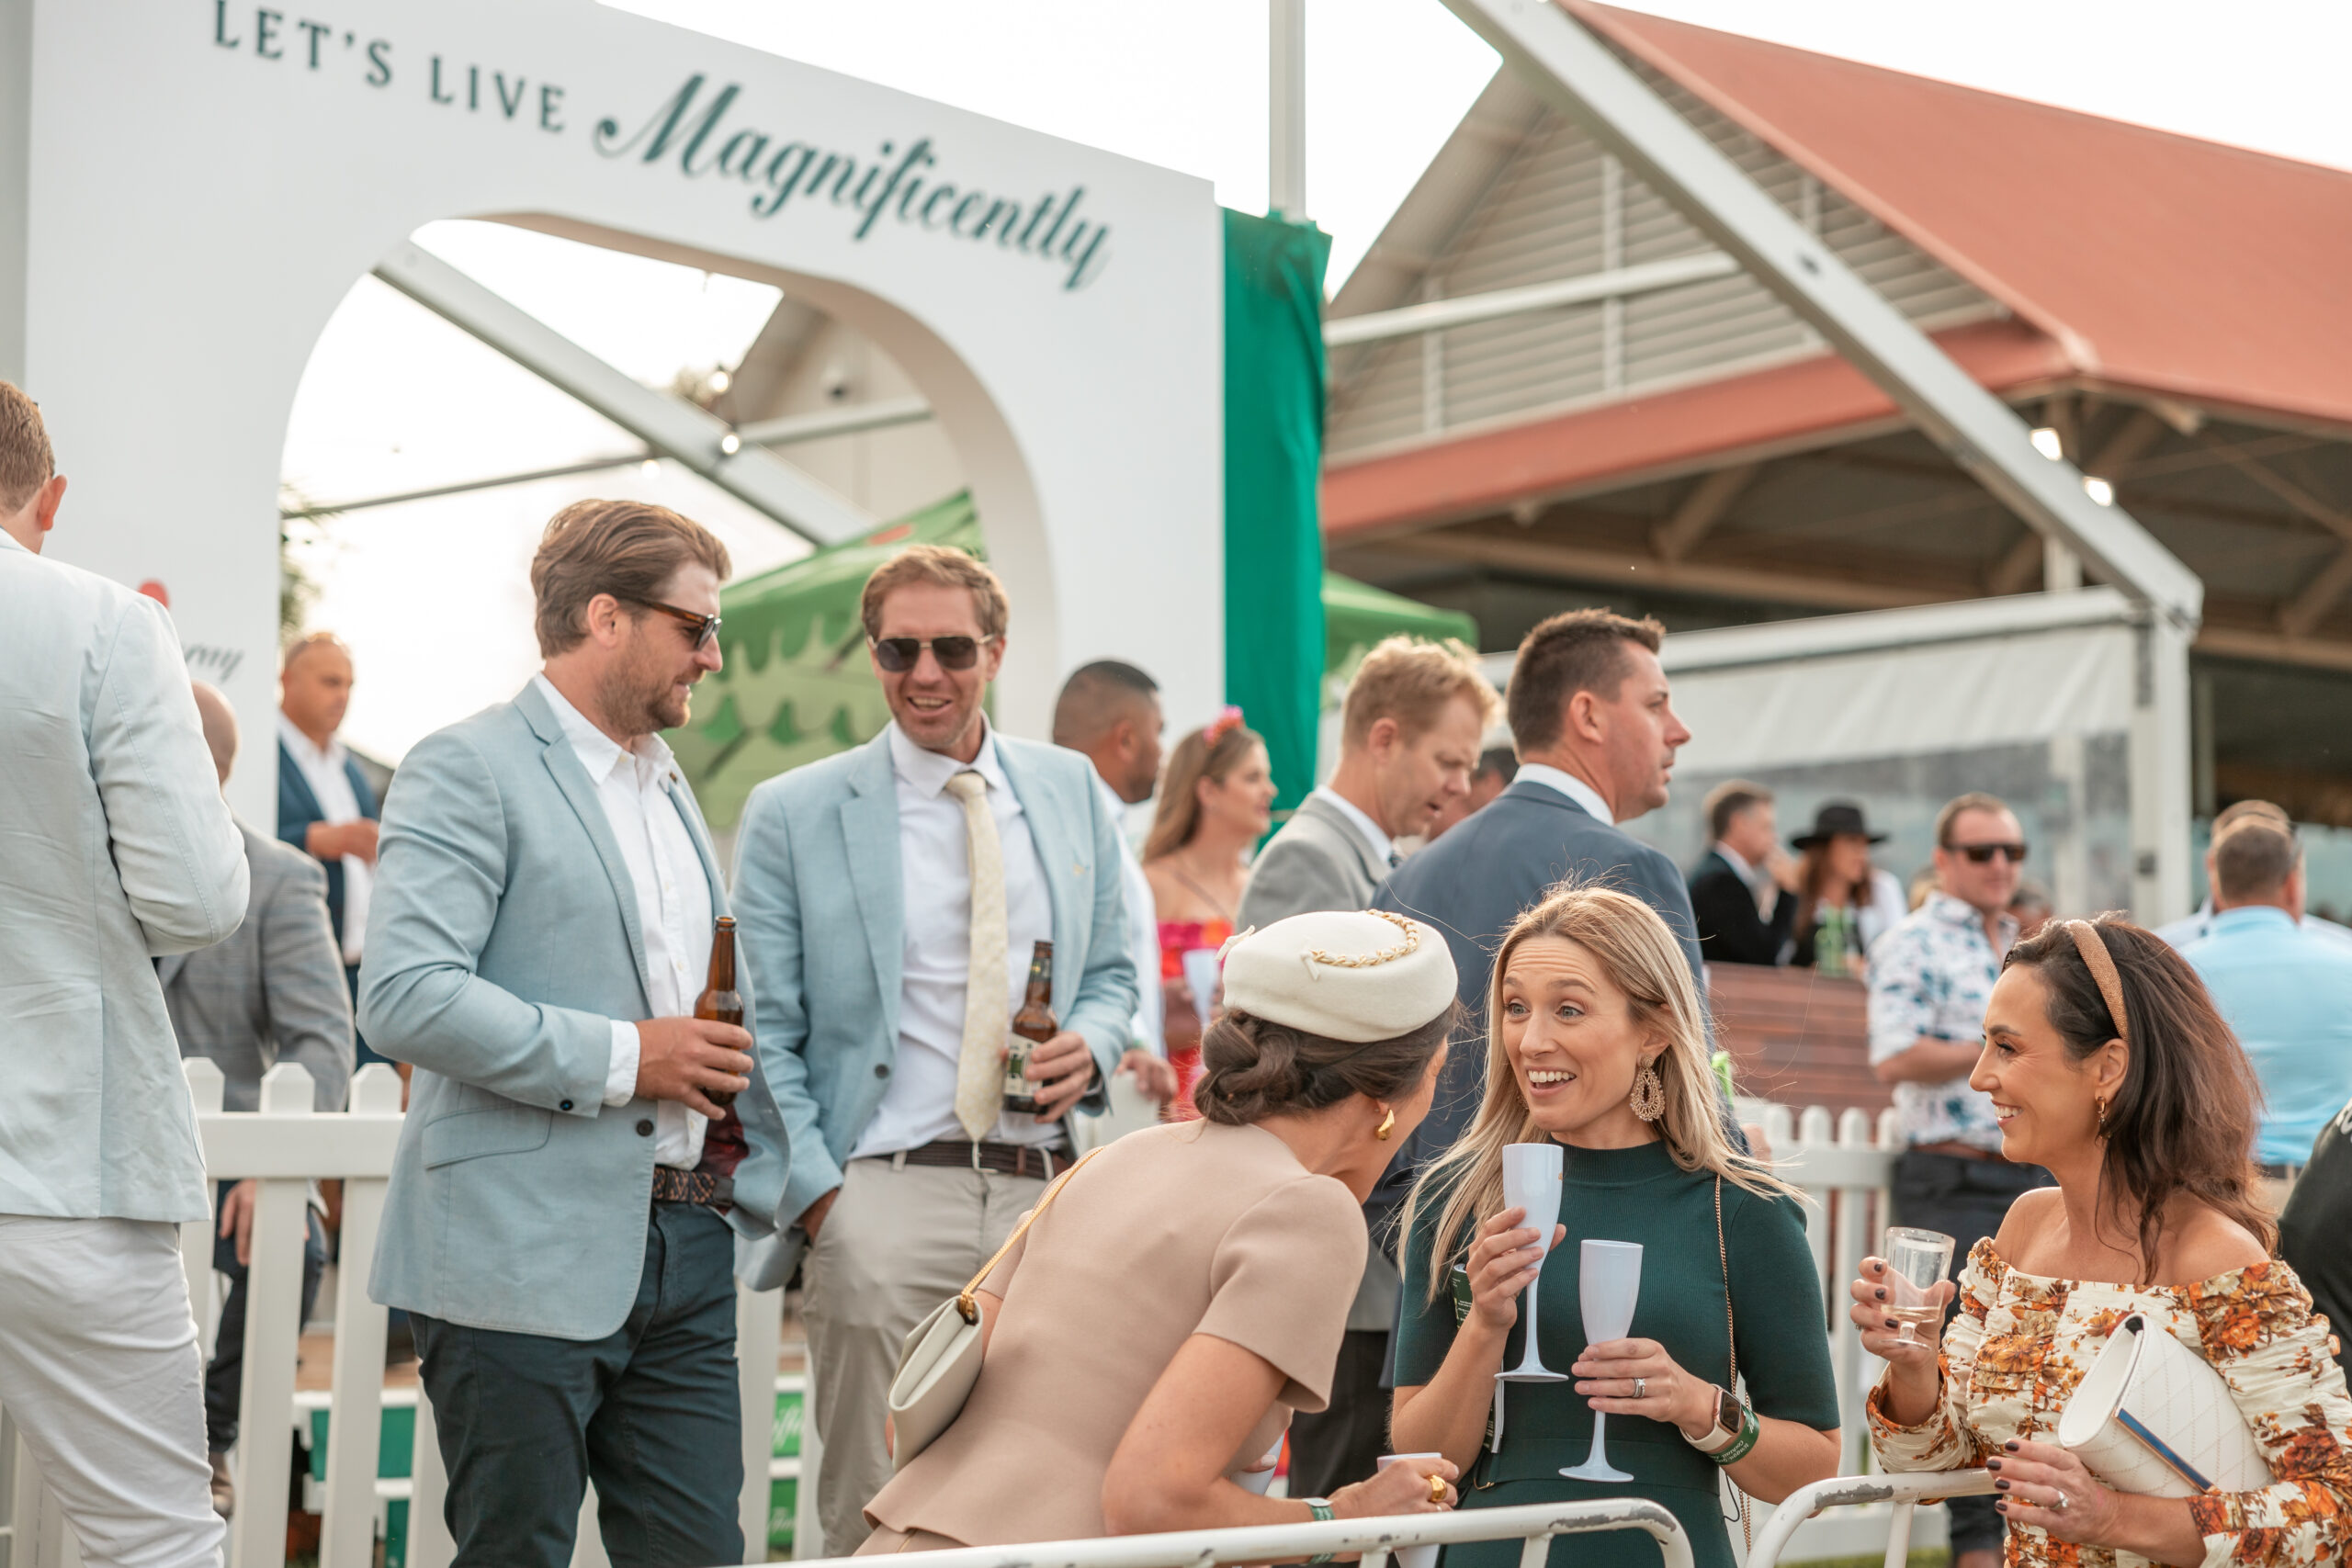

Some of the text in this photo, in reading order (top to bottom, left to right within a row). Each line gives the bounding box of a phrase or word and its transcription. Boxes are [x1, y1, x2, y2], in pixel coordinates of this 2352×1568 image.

[214, 0, 1110, 292] LET'S LIVE Magnificently
